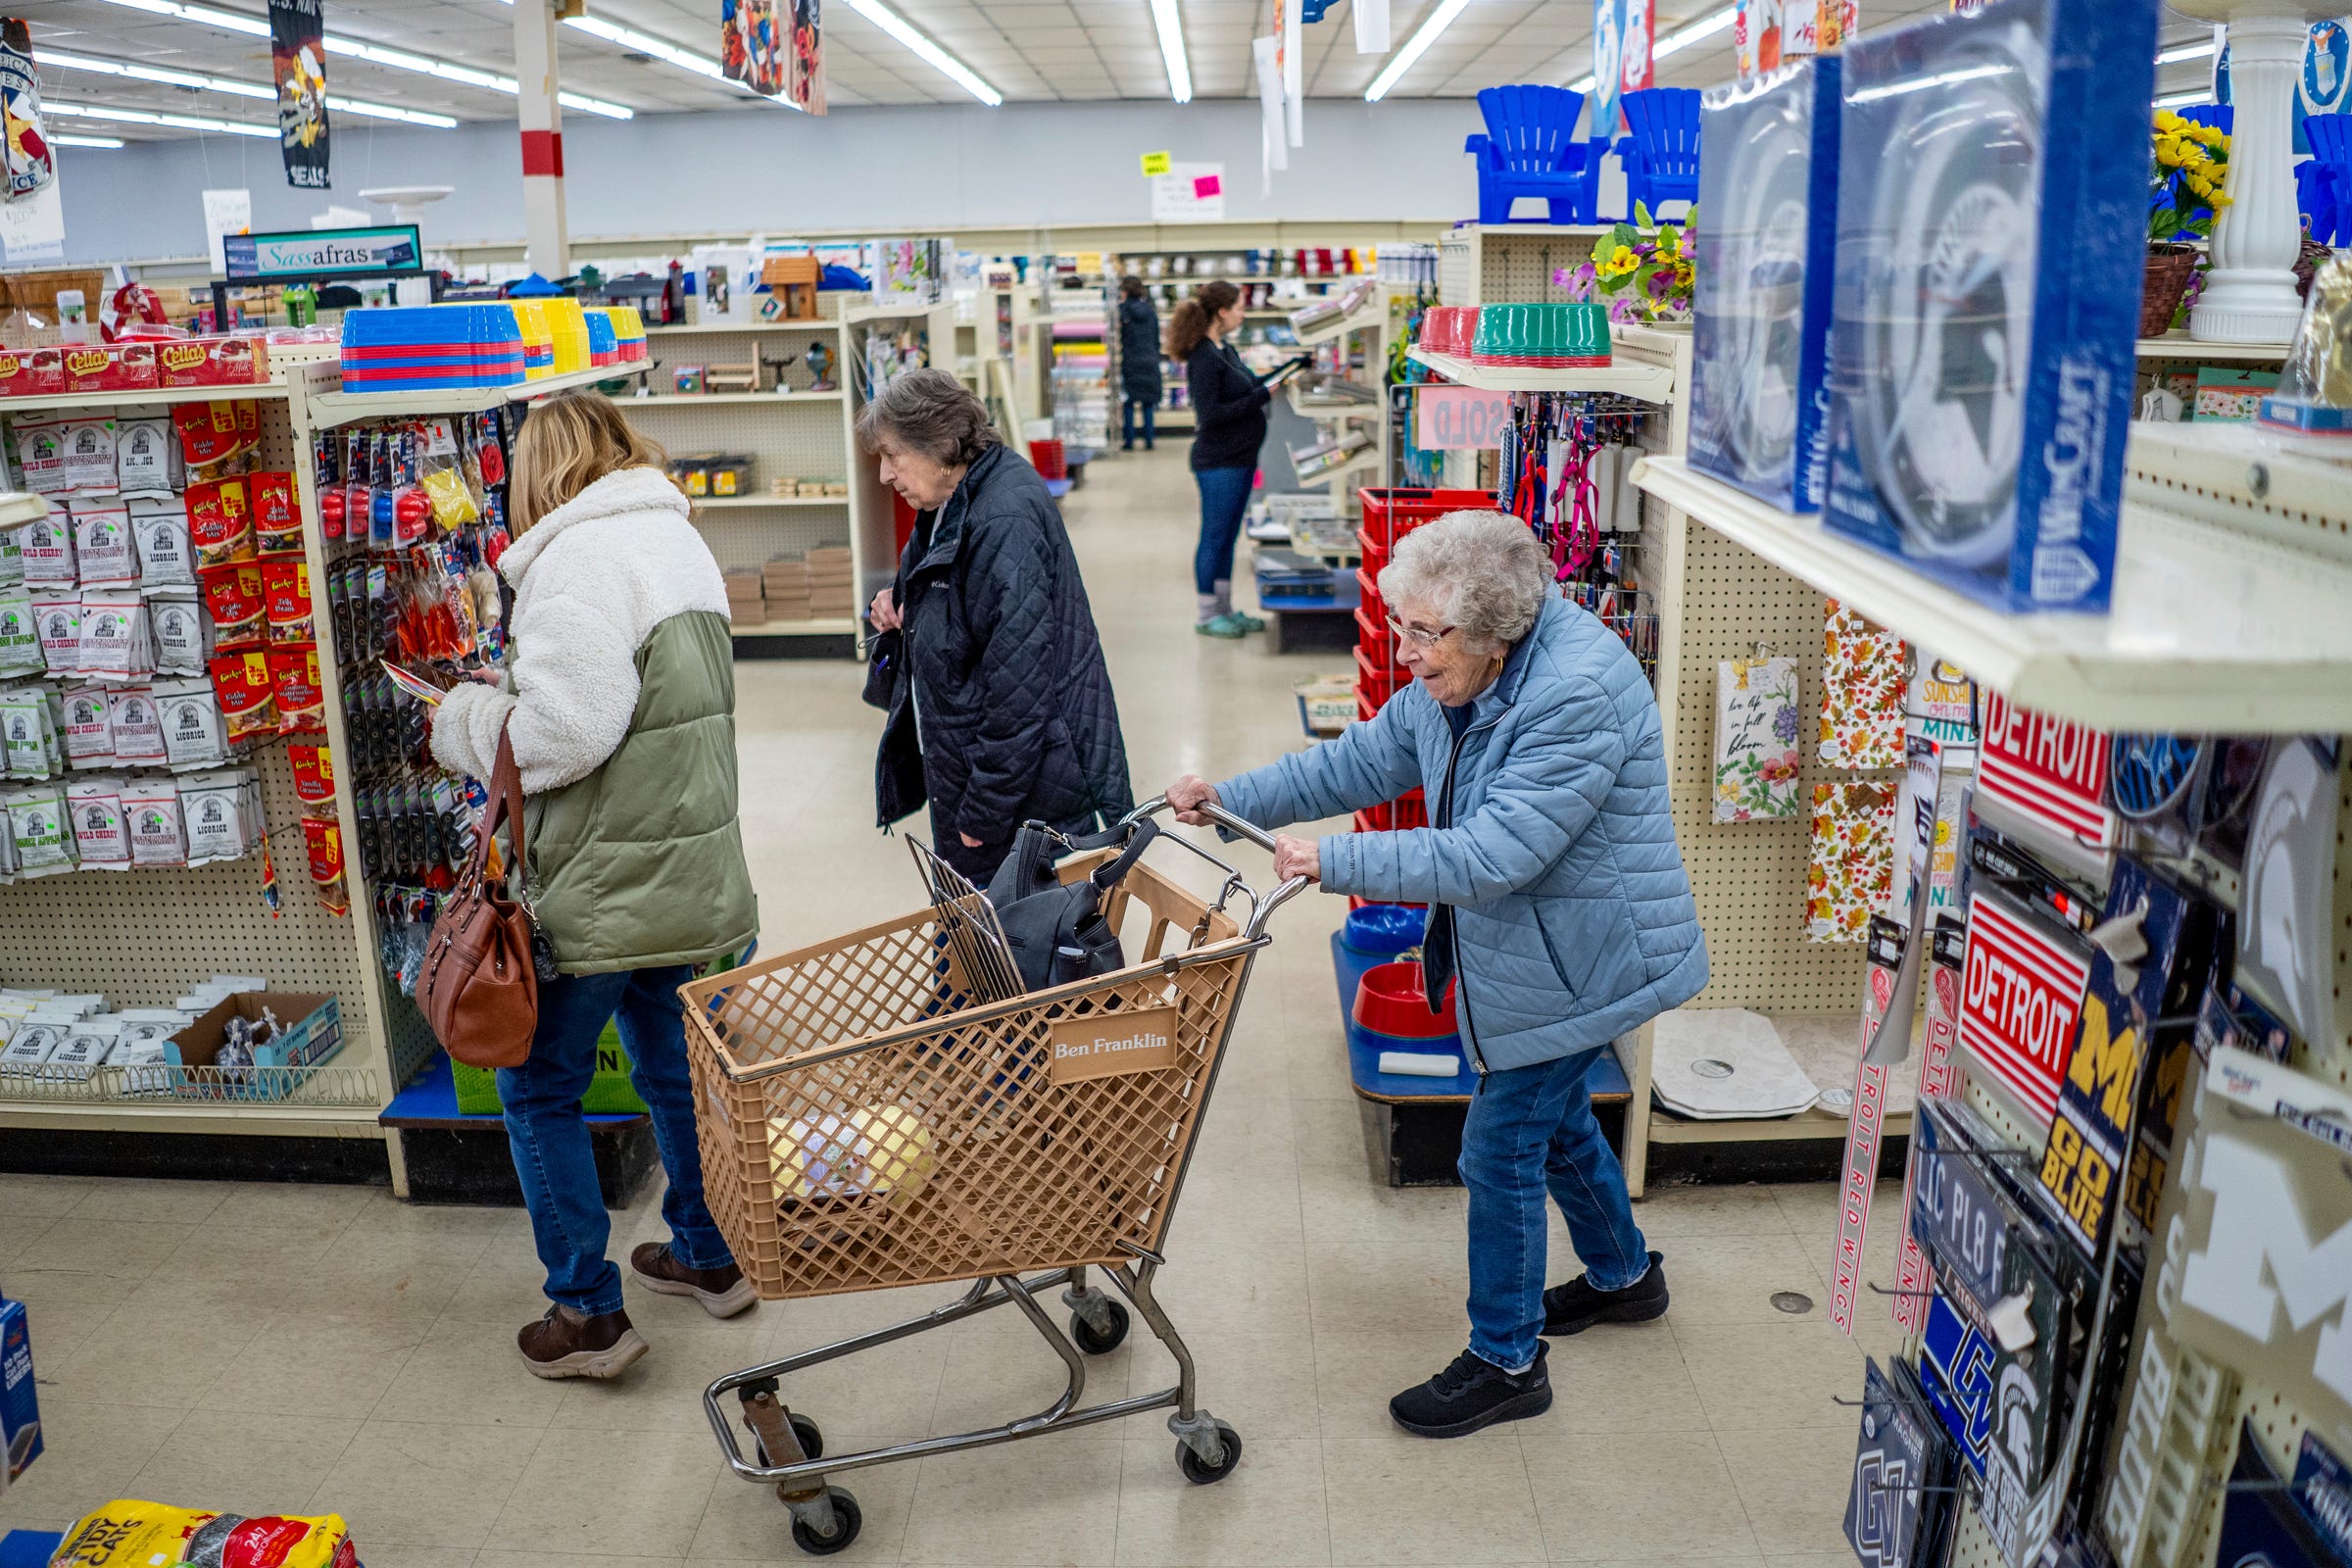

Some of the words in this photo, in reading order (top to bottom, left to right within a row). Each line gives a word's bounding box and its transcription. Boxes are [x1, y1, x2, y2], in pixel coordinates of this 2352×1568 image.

[262, 244, 369, 270] Sassafras
[67, 350, 110, 371] Cella's
[162, 345, 207, 368] Cella's
[23, 460, 40, 471] WILD
[126, 457, 154, 466] LICICE
[23, 548, 37, 558] WILD
[39, 548, 64, 558] CHERRY
[149, 552, 179, 563] LICORICE
[58, 638, 79, 649] CHERRY
[1929, 704, 1951, 717] on
[66, 725, 80, 735] WILD
[82, 723, 105, 733] CHERRY
[175, 729, 205, 741] LICORICE
[1727, 734, 1766, 759] bloom
[77, 831, 94, 841] WILD
[95, 830, 118, 840] CHERRY
[197, 824, 227, 834] LICORICE
[1967, 944, 2072, 1073] DETROIT
[13, 1047, 40, 1056] LICORICE
[58, 1052, 87, 1063] LICORICE
[1054, 1044, 1090, 1059] Ben
[1093, 1033, 1168, 1054] Franklin
[1927, 1020, 1949, 1098] DETR
[2051, 1115, 2111, 1200] GO
[1847, 1168, 1865, 1225] RED
[1917, 1138, 1945, 1224] LIC
[1951, 1182, 1986, 1276] PL8
[2040, 1147, 2104, 1242] BLUE
[1835, 1237, 1856, 1329] WINGS
[1897, 1236, 1920, 1329] WINGS
[6, 1360, 32, 1392] LINERS
[1891, 1411, 1923, 1463] MAGNET
[74, 1518, 120, 1566] TIDY
[87, 1519, 144, 1567] CATS
